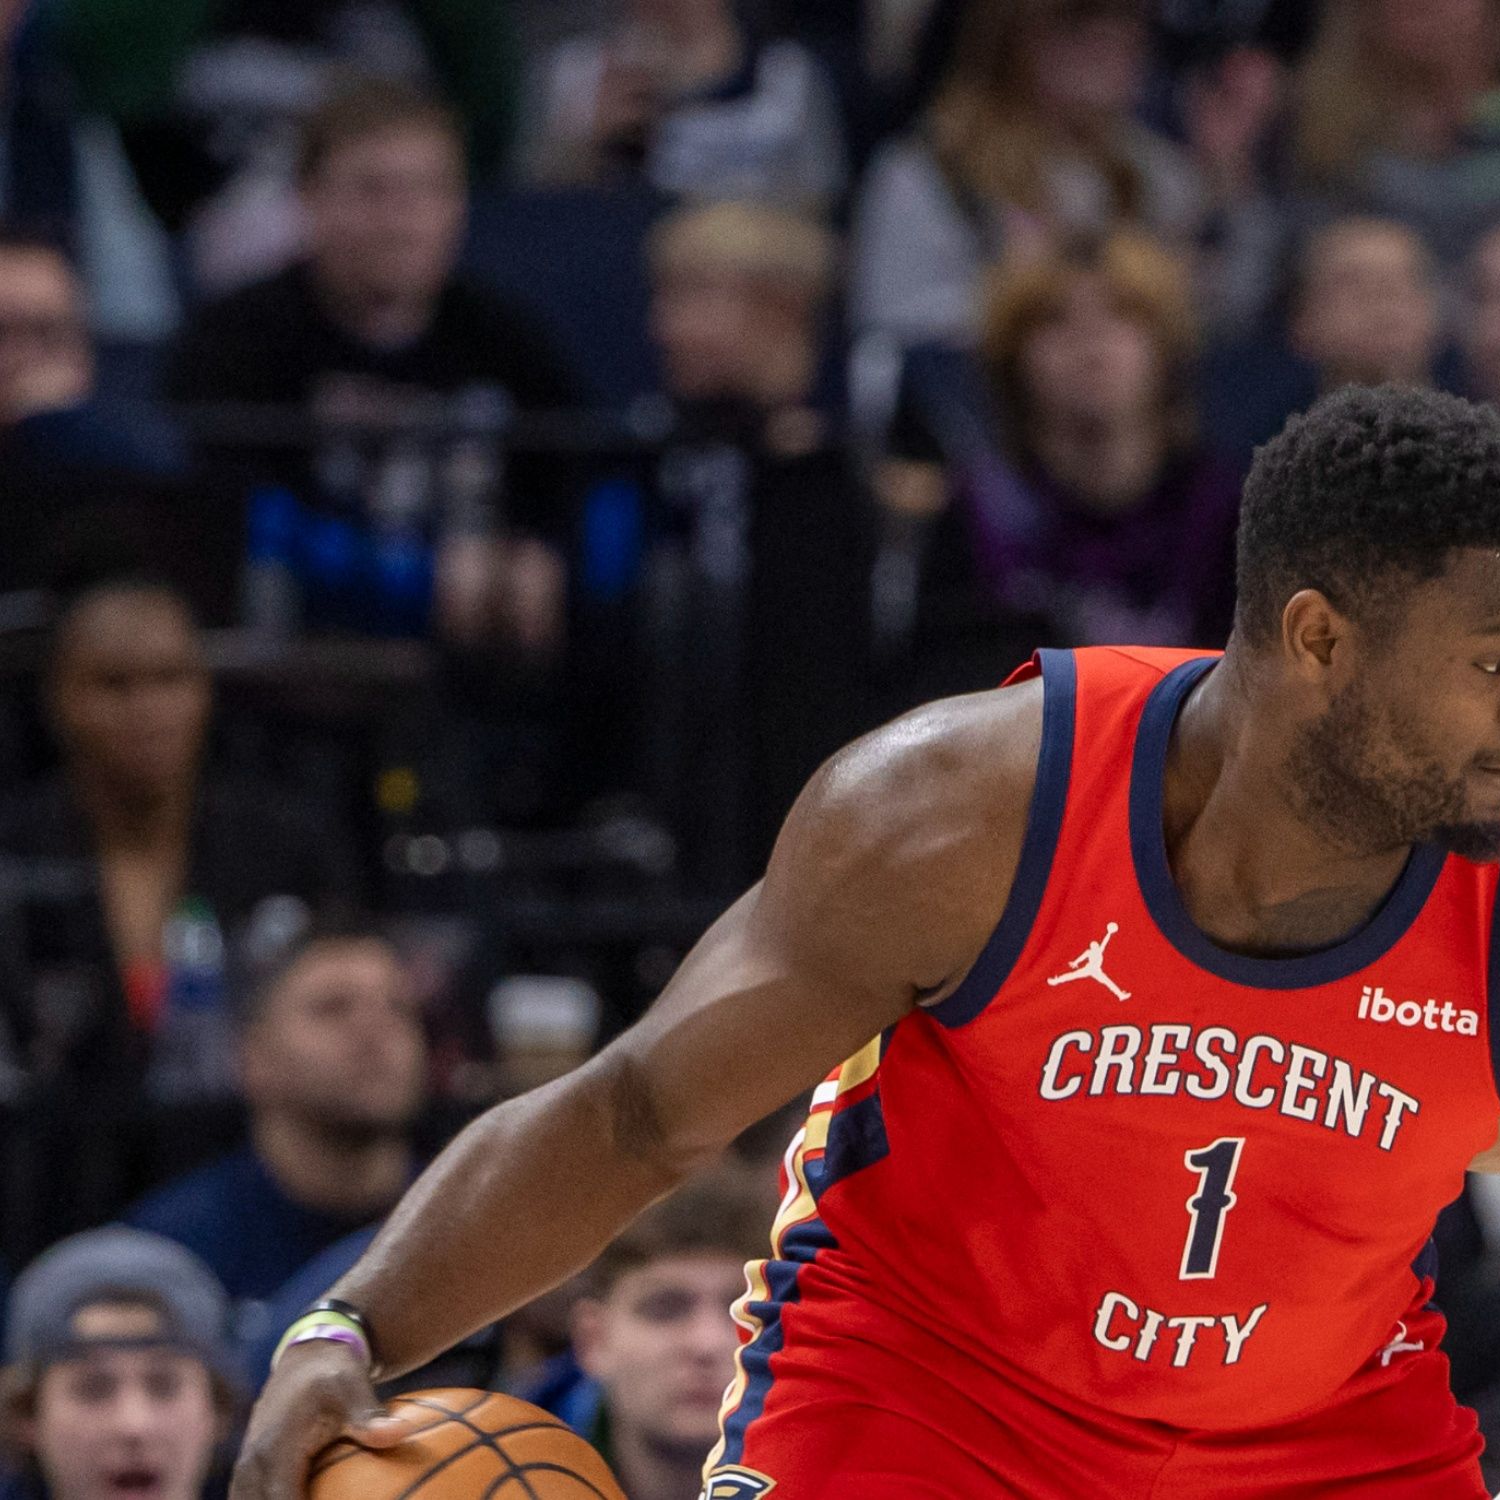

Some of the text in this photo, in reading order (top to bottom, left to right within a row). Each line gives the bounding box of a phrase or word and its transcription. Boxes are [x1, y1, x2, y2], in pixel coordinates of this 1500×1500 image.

[1357, 986, 1479, 1036] ibotta
[1039, 1024, 1419, 1151] CRESCENT
[1179, 1137, 1246, 1280] 1
[1093, 1291, 1268, 1368] CITY
